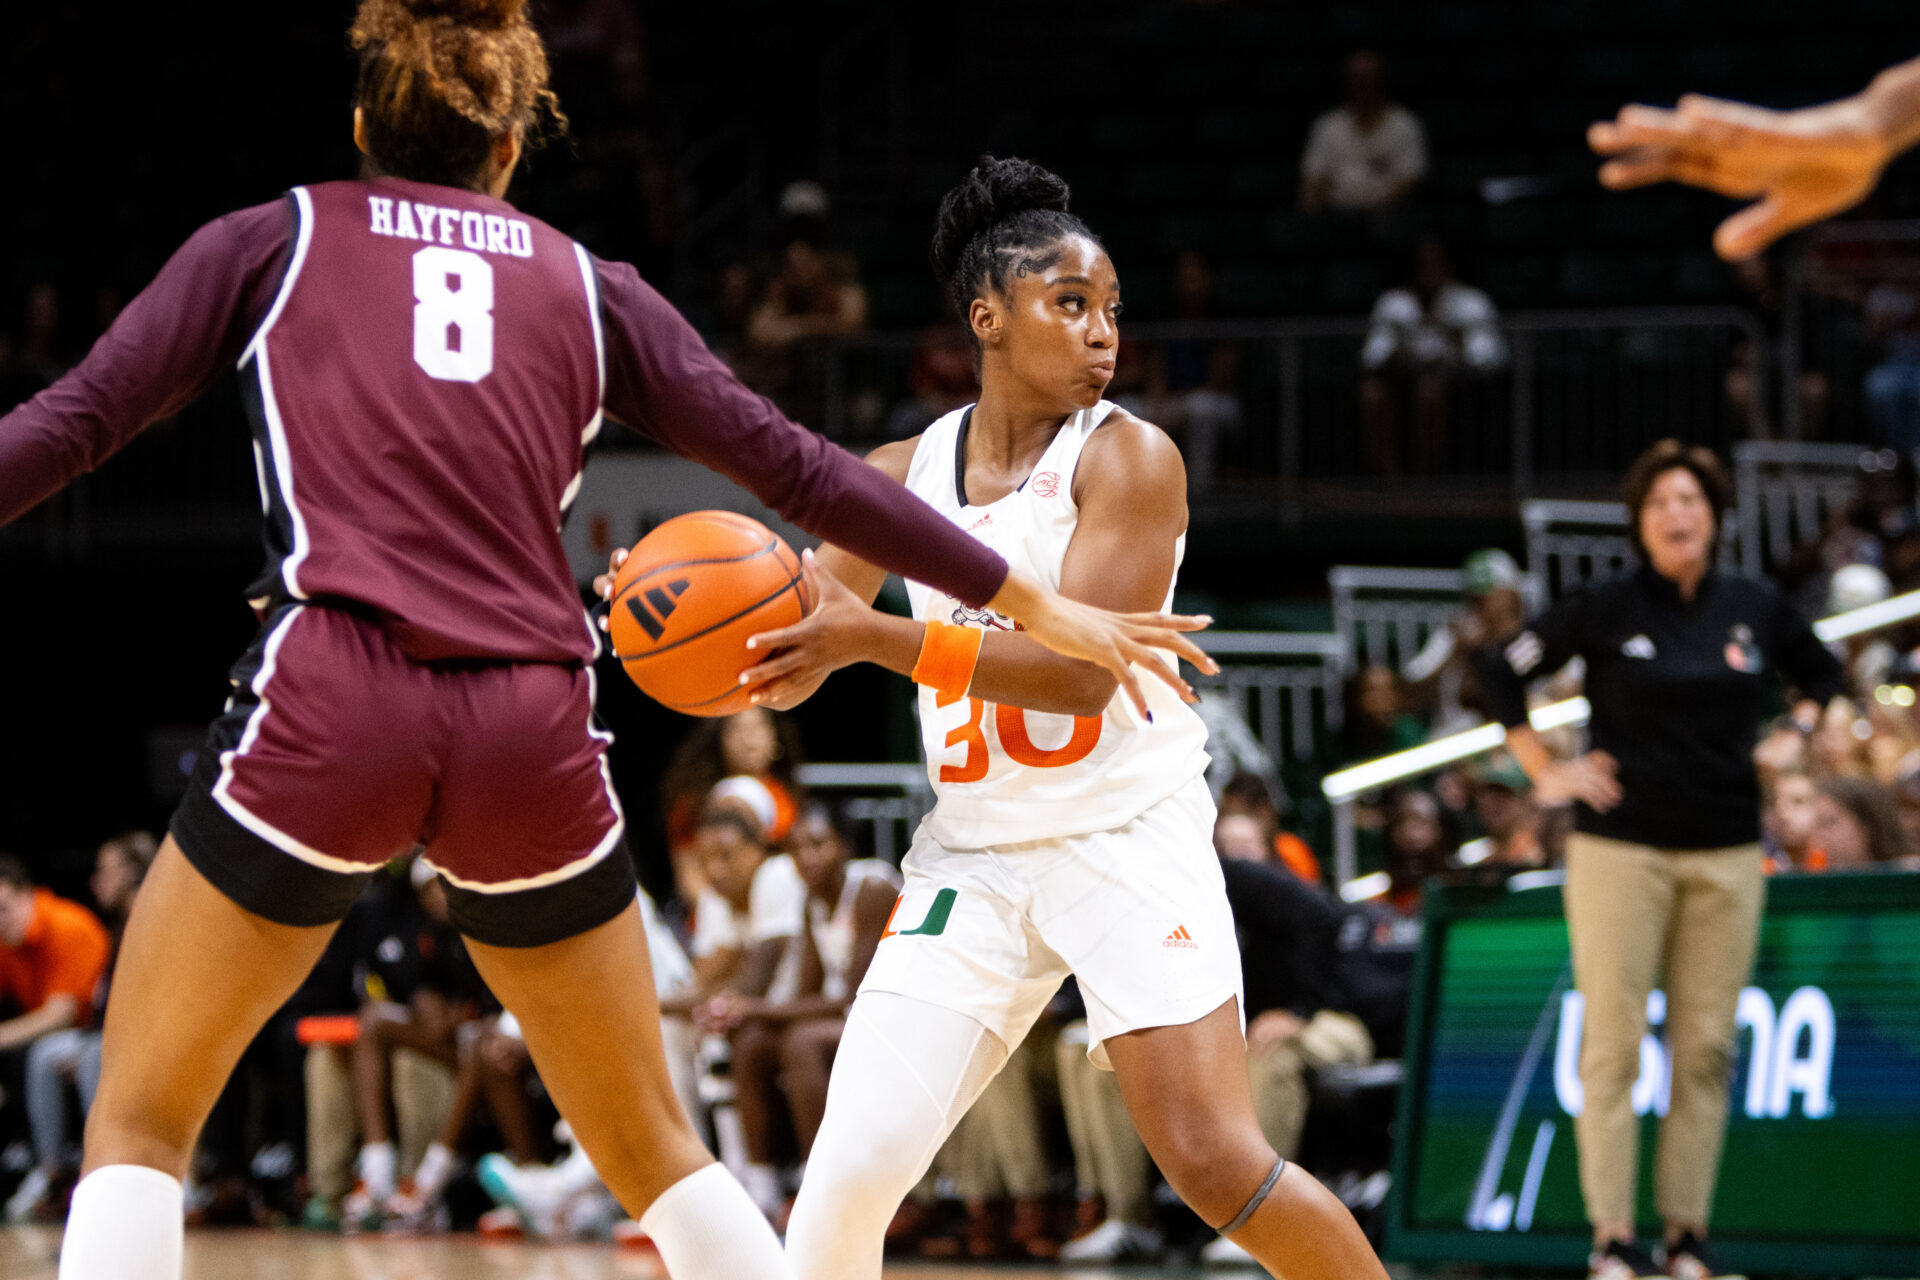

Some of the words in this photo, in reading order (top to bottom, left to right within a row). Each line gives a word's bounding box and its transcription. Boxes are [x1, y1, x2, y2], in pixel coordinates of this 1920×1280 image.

[368, 196, 534, 259] HAYFORD
[412, 245, 495, 384] 8
[935, 689, 1103, 784] 30
[1162, 939, 1199, 950] adidas
